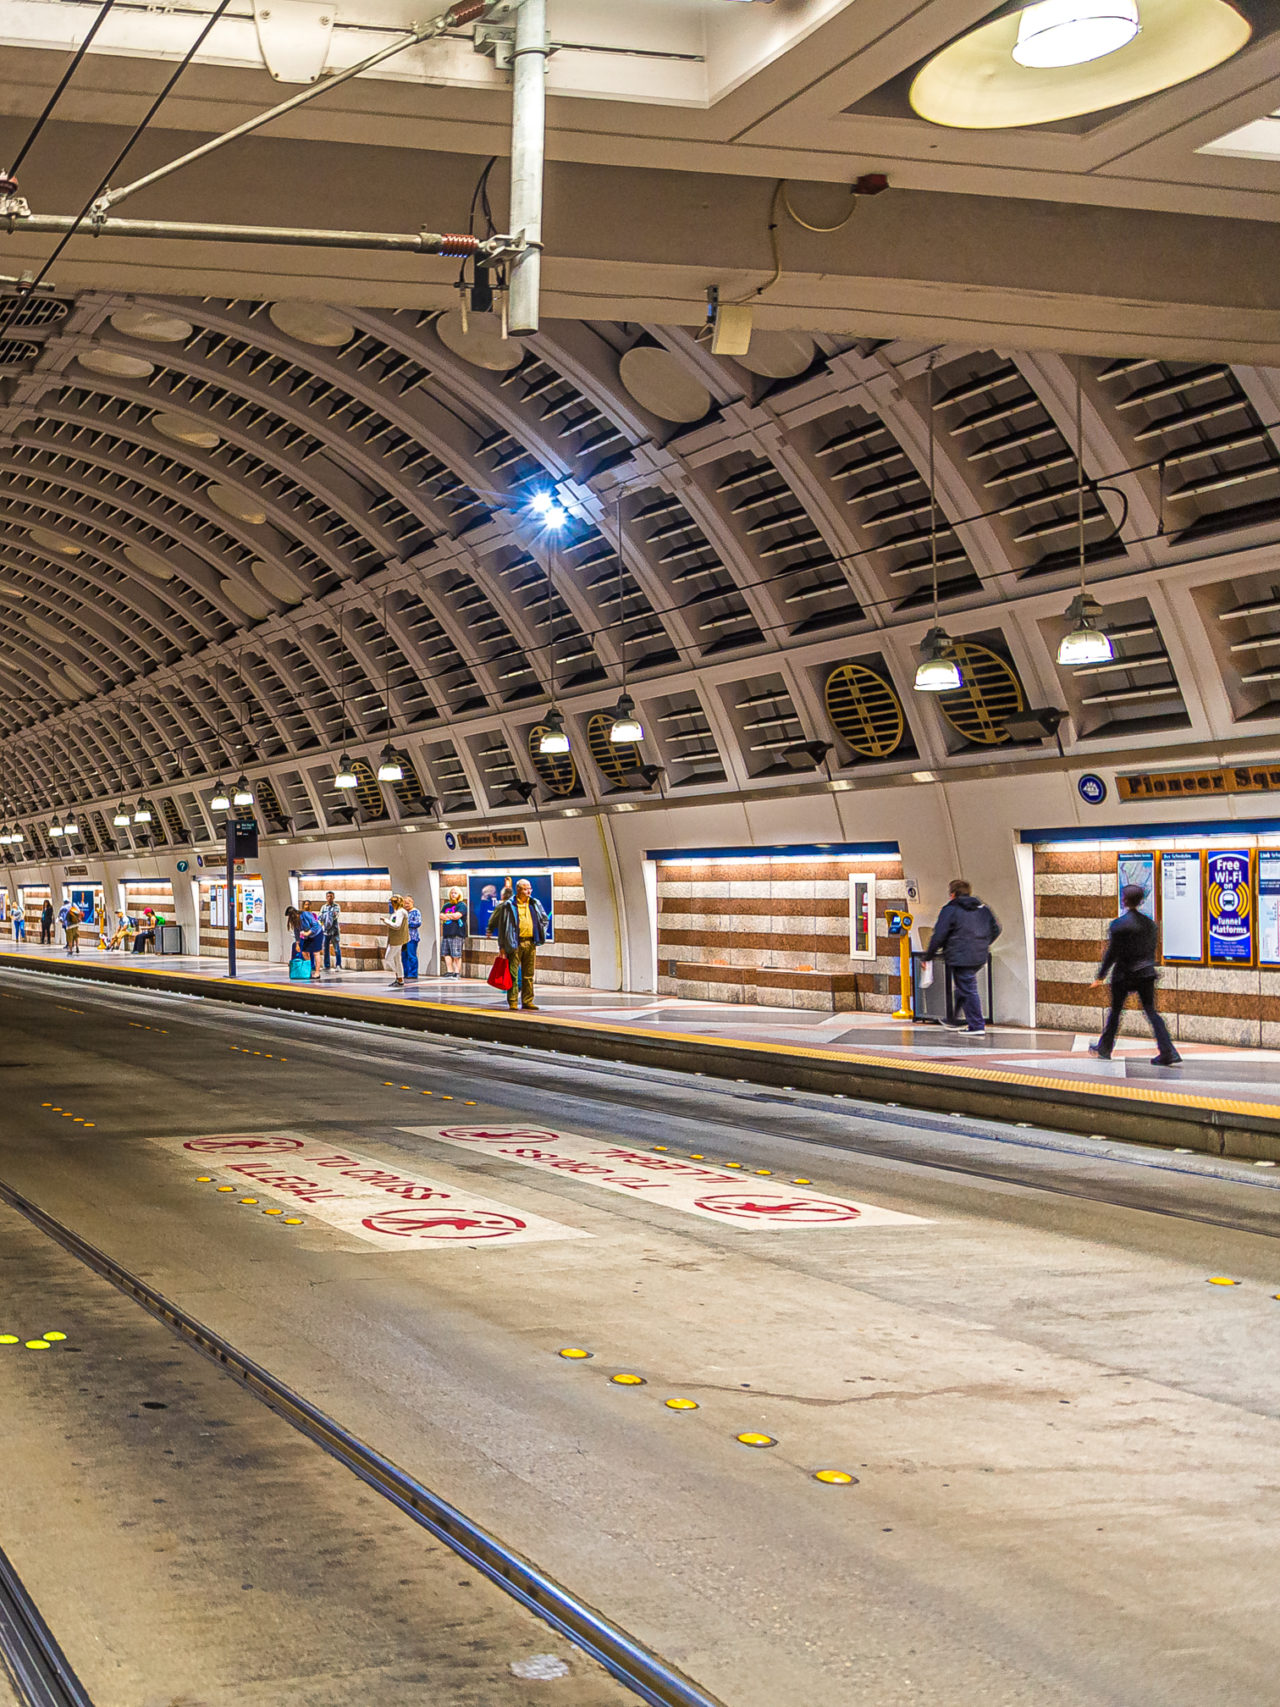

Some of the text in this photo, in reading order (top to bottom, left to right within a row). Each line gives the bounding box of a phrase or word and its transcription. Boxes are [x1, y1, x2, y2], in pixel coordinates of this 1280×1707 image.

[1128, 775, 1223, 794] Pioneer
[1217, 859, 1240, 870] Free
[1215, 871, 1242, 883] Wi-Fi
[1212, 925, 1247, 934] Platforms
[1218, 916, 1241, 925] Tunnel
[499, 1148, 670, 1189] TO CROSS
[591, 1148, 748, 1183] ILLEGAL
[225, 1163, 344, 1203] ILLEGAL
[304, 1155, 451, 1200] TO CROSS
